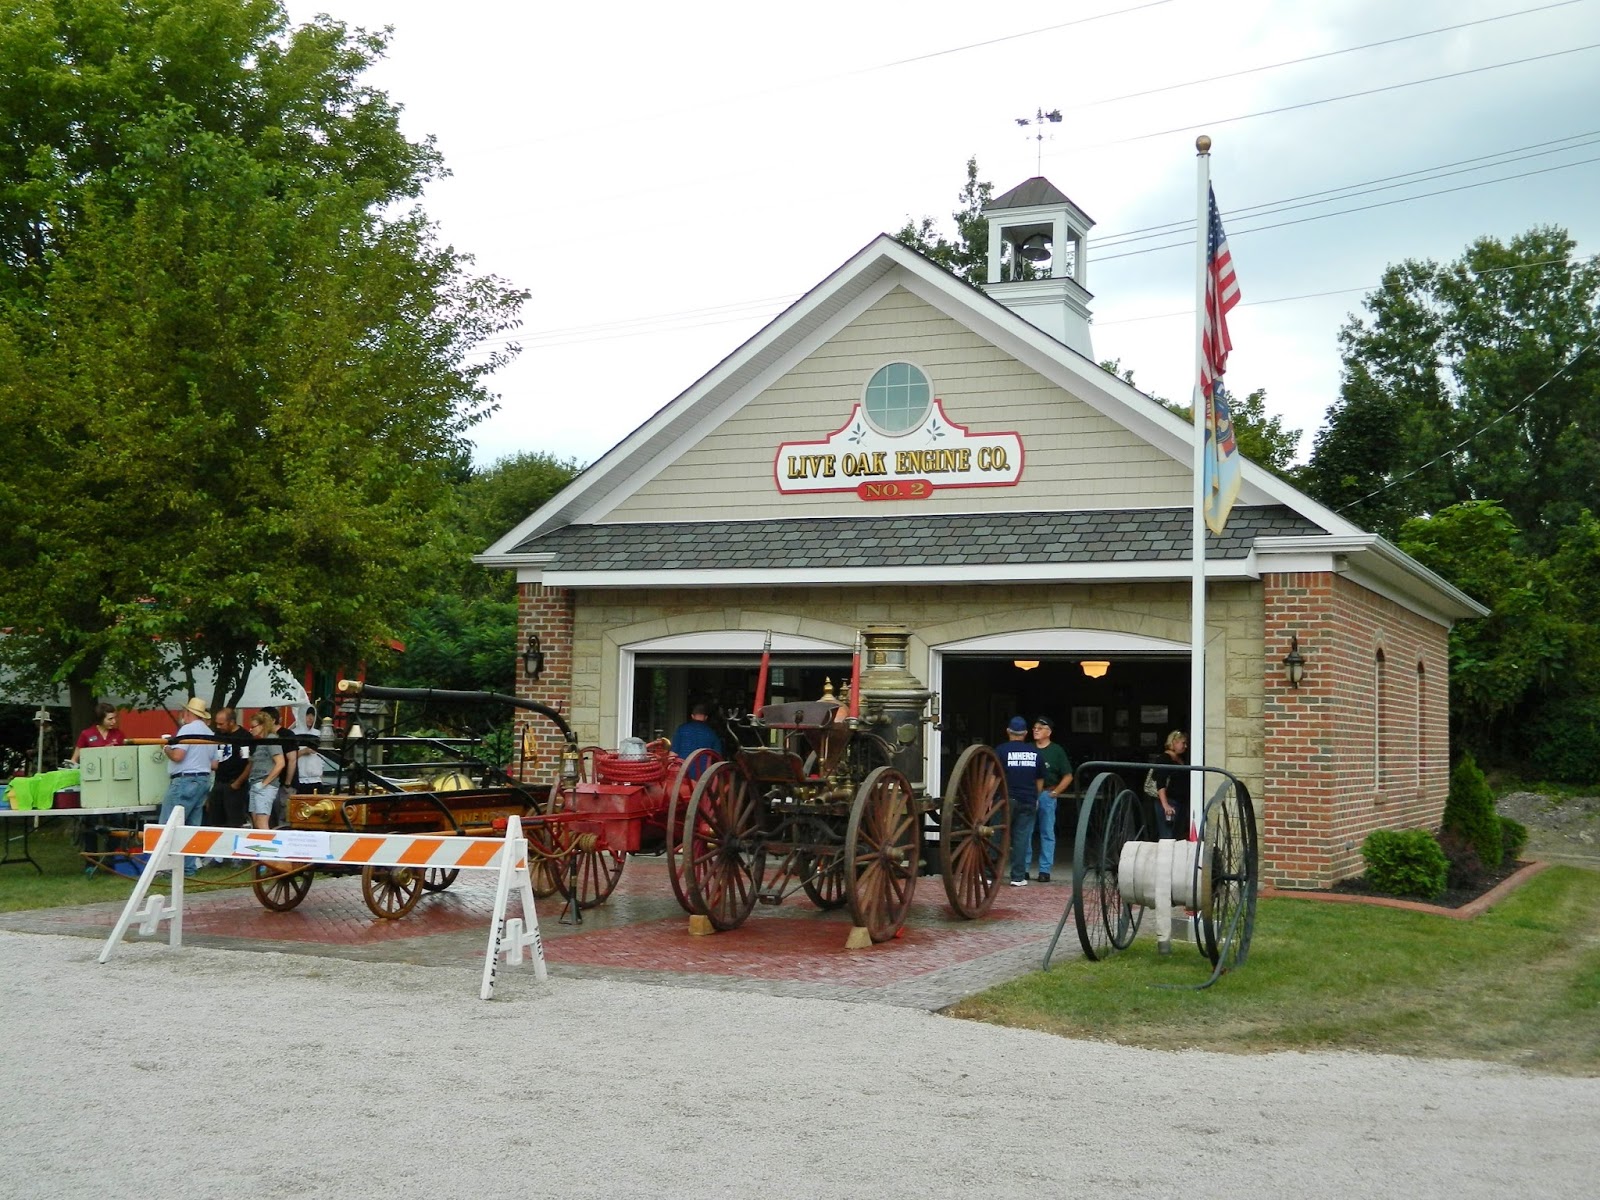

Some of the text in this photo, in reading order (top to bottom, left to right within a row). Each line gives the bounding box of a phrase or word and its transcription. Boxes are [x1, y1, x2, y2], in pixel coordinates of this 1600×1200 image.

[787, 446, 1010, 479] LIVE OAK ENGINE CO.
[866, 482, 925, 497] NO. 2
[1007, 751, 1037, 761] AMHERST
